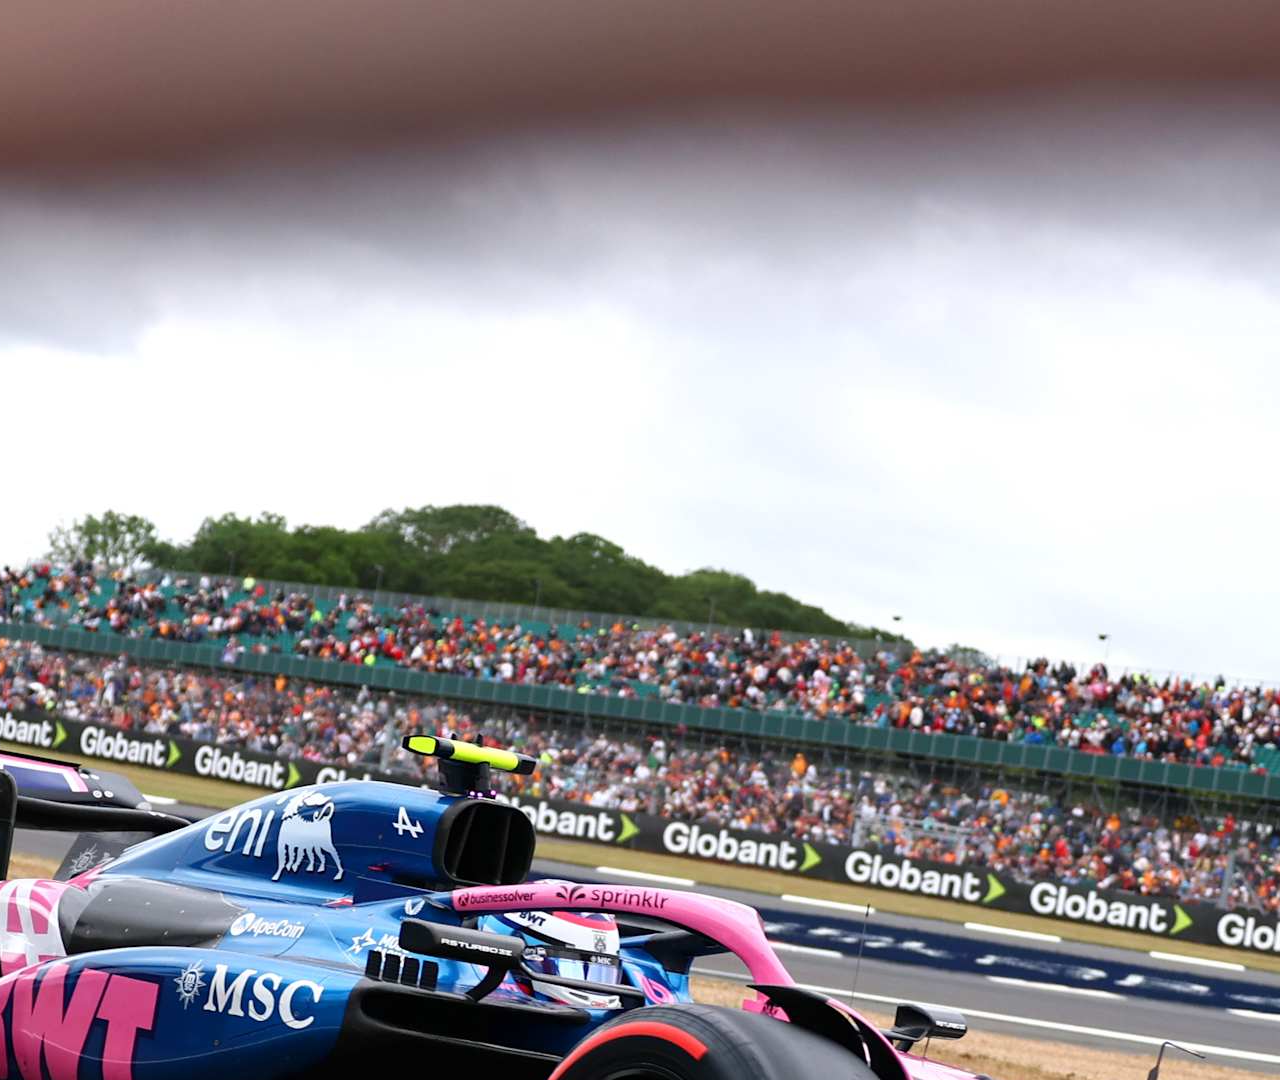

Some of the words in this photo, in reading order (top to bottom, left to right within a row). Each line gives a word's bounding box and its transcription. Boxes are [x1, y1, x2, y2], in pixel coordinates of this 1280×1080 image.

[81, 726, 165, 767] Globant
[195, 745, 284, 789] Globant
[204, 796, 287, 857] eni
[664, 822, 797, 870] Globant
[471, 890, 535, 904] businessolver
[591, 889, 669, 909] sprinklr
[845, 851, 981, 901] Globant
[250, 919, 305, 939] ApeCoin
[1030, 883, 1168, 934] Globant
[203, 963, 325, 1029] MSC
